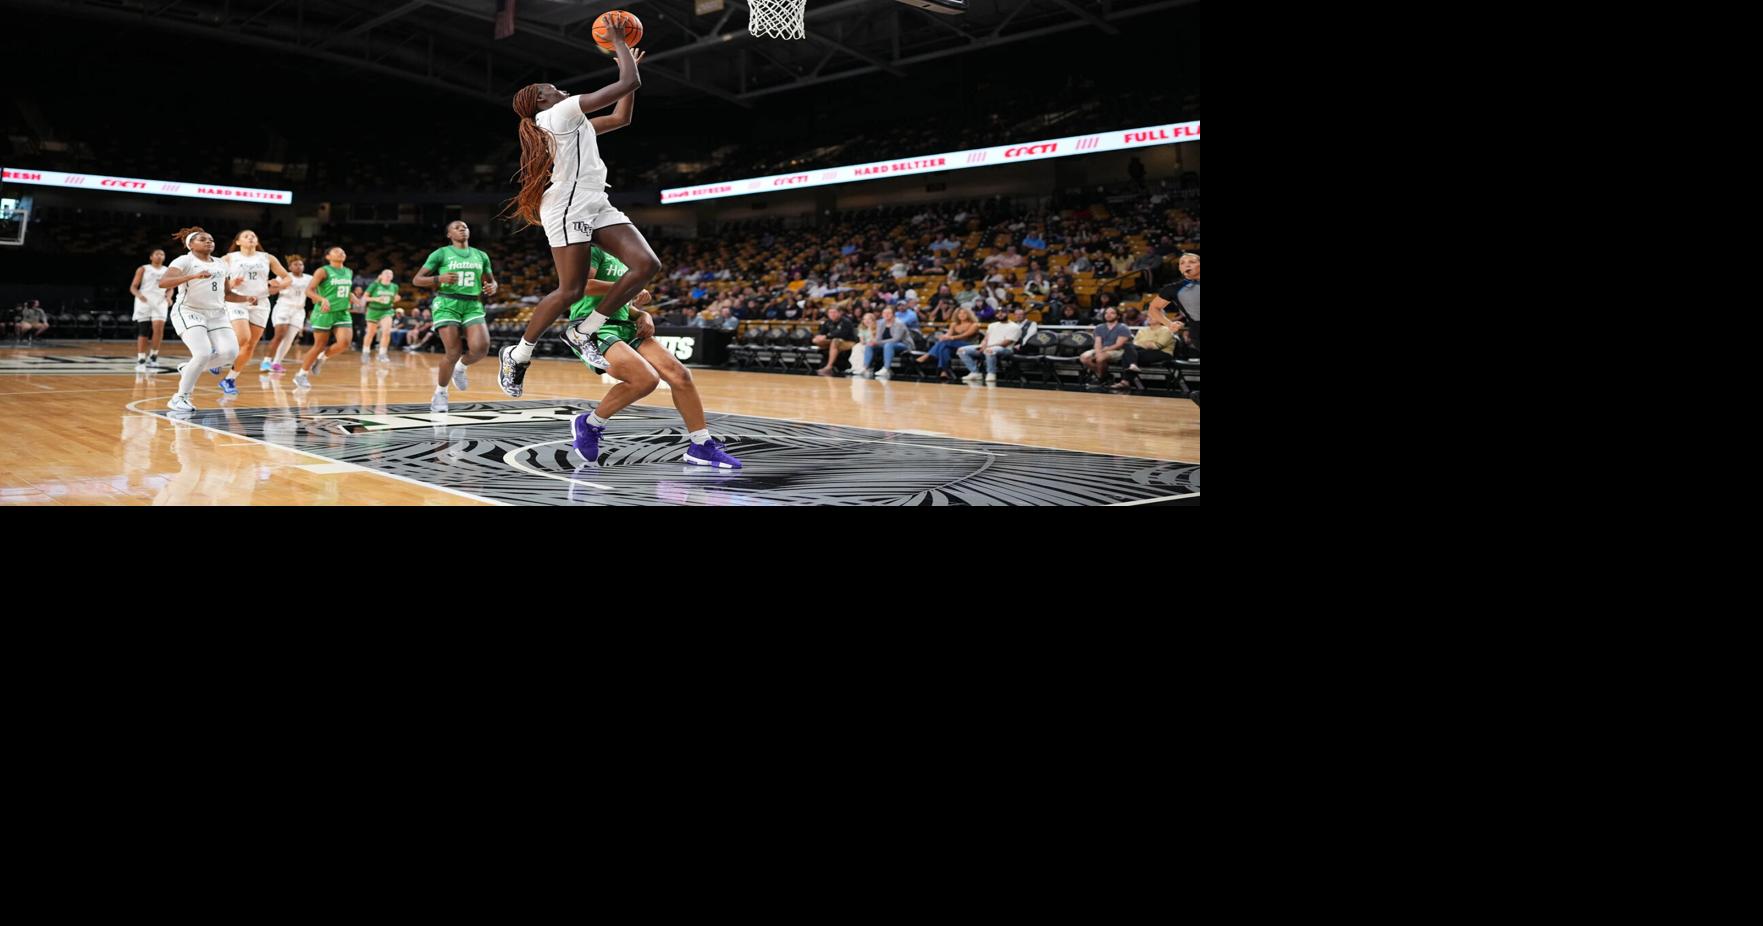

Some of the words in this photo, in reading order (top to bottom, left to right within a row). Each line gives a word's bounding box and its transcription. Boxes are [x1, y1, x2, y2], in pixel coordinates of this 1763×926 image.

[1124, 130, 1169, 143] FULL
[854, 164, 889, 176] HARD
[892, 158, 946, 171] SELTZER
[198, 187, 232, 196] HARD
[248, 271, 258, 280] 12
[457, 271, 475, 287] 12
[211, 281, 218, 292] 8
